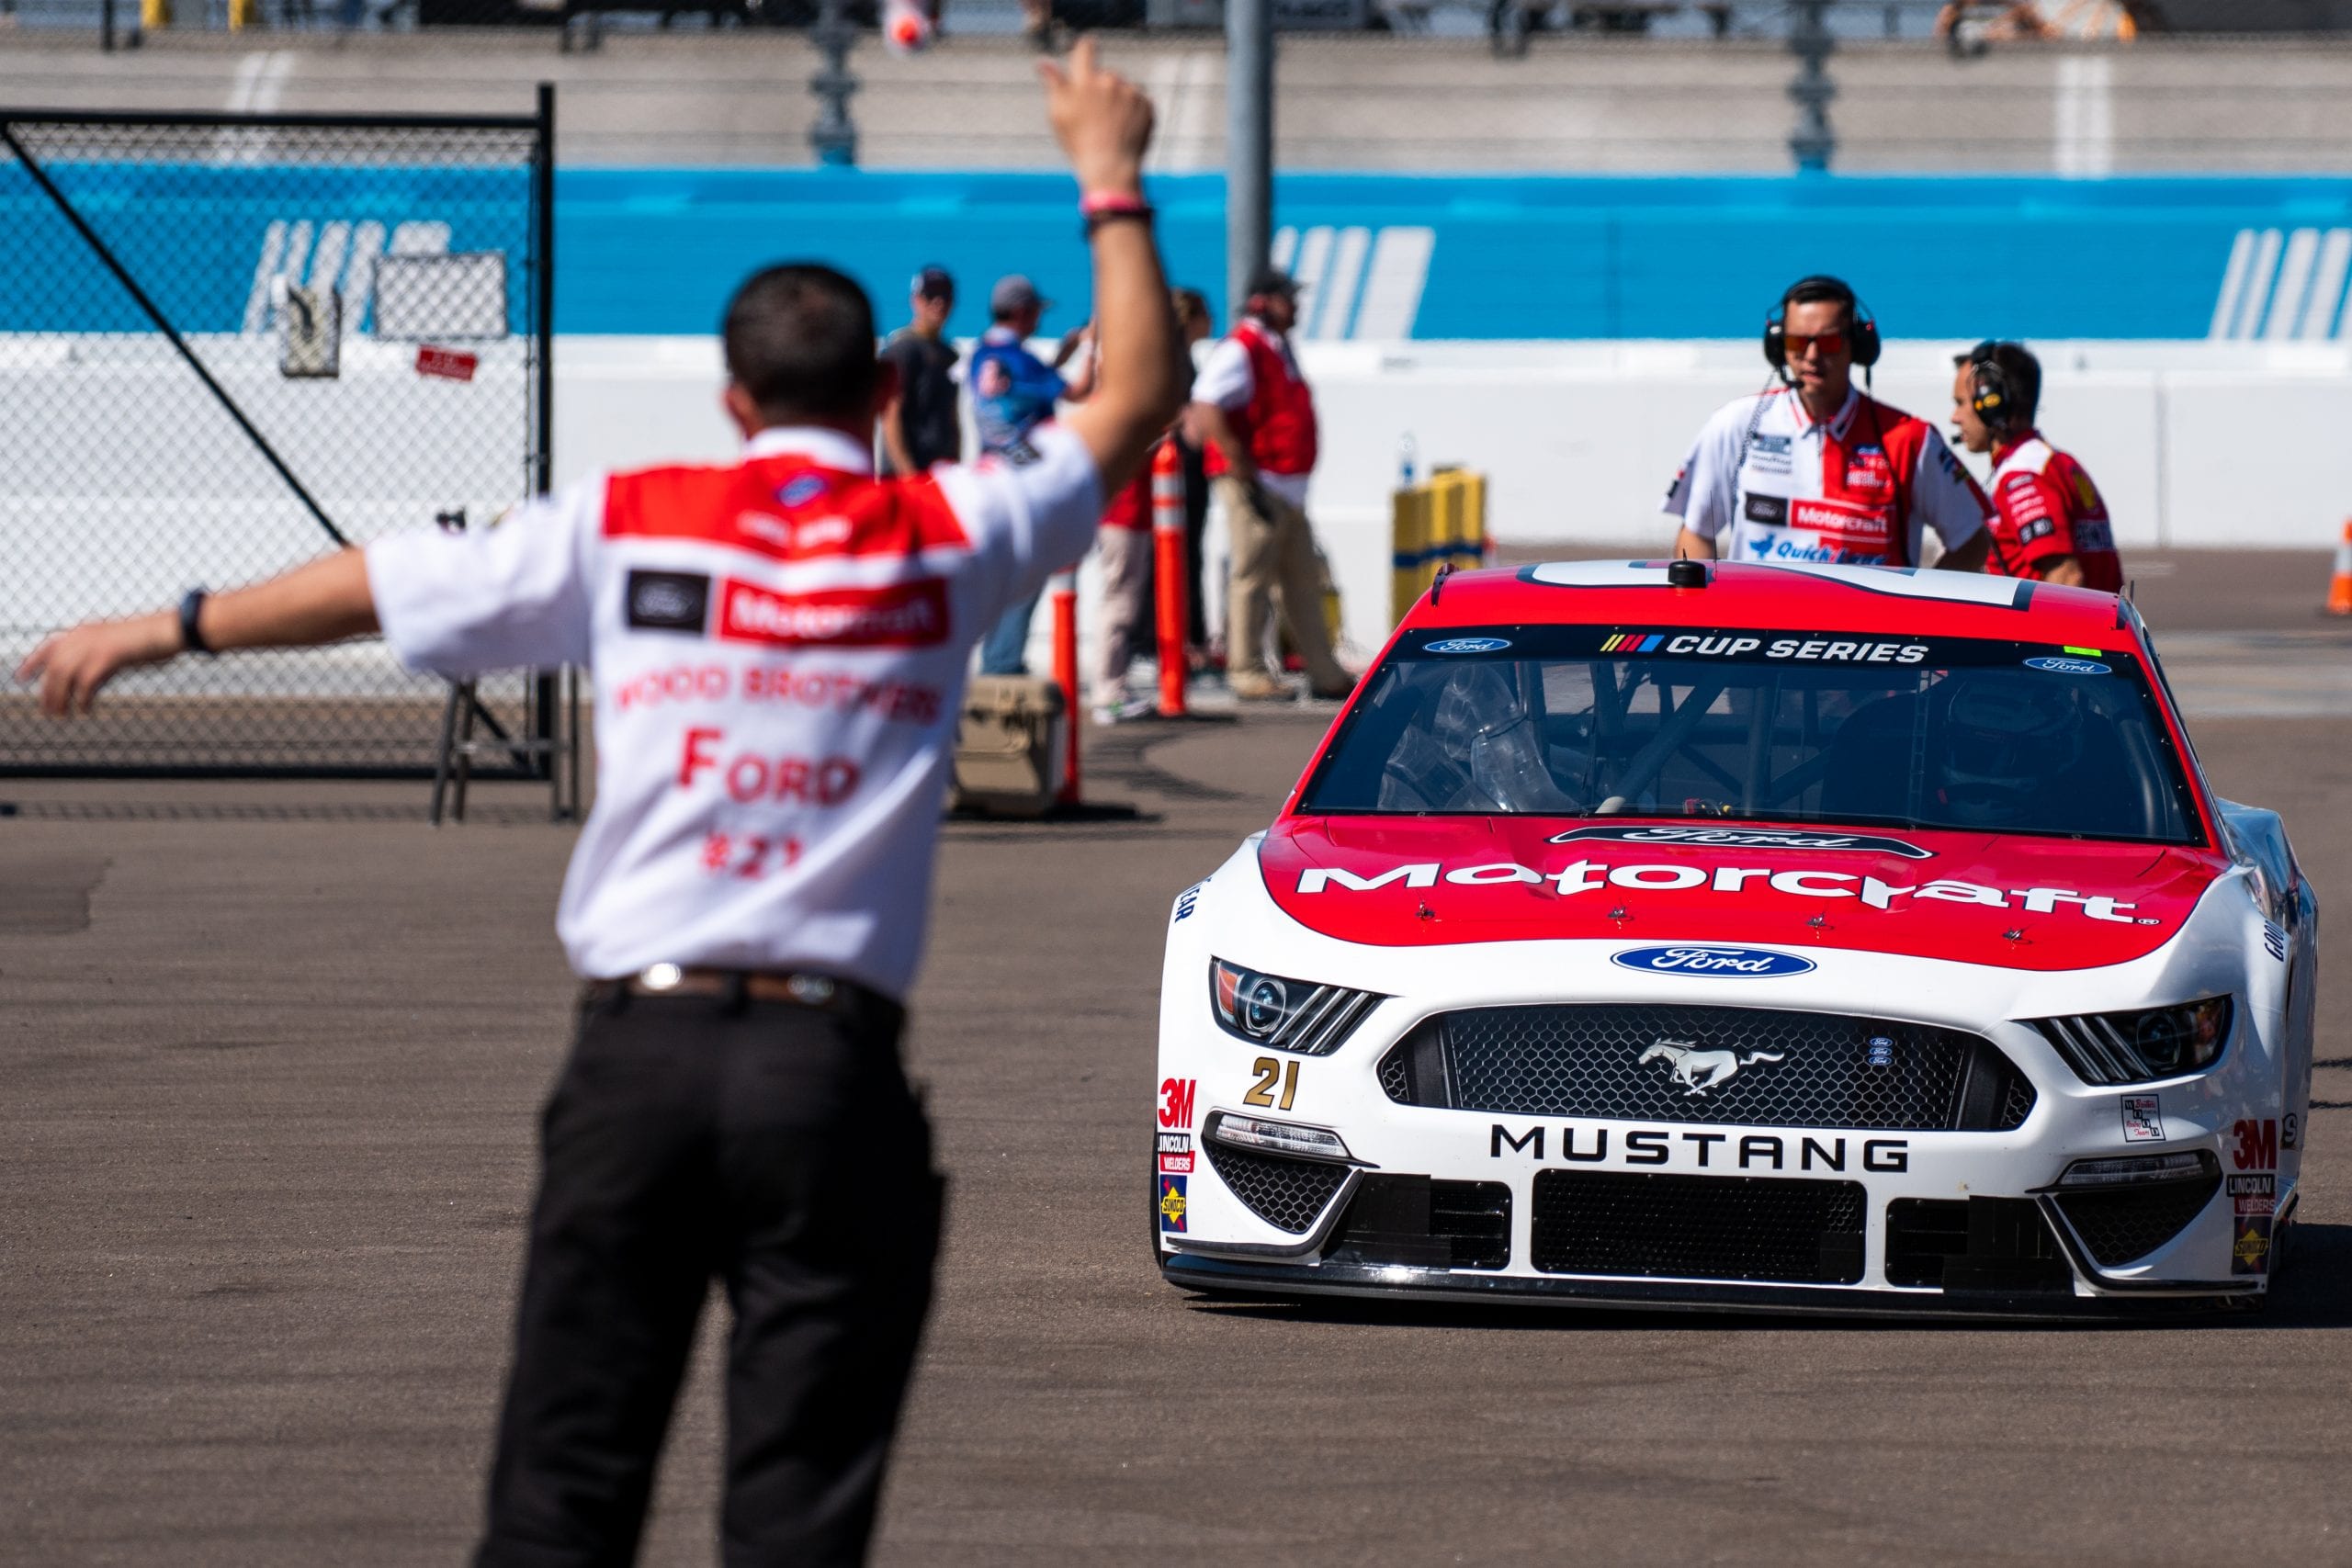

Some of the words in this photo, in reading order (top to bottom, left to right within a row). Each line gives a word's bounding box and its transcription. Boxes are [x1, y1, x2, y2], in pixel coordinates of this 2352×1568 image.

[1798, 508, 1887, 532] Motorcraft
[1777, 542, 1832, 563] Quick
[1440, 638, 1495, 651] Ford
[1666, 635, 1761, 656] CUP
[1765, 639, 1929, 663] SERIES
[2042, 659, 2095, 672] Ford
[1623, 827, 1861, 848] Ford
[1296, 859, 2138, 924] Motorcraft
[1651, 945, 1776, 973] Ford
[1242, 1056, 1301, 1111] 21
[1158, 1077, 1197, 1130] 3M
[1490, 1124, 1908, 1173] MUSTANG
[2233, 1118, 2278, 1170] 3M
[1163, 1156, 1192, 1171] WELDERS
[2229, 1178, 2272, 1194] LINCOLN
[1162, 1198, 1184, 1213] SUNOCO
[2238, 1198, 2277, 1213] WELDERS
